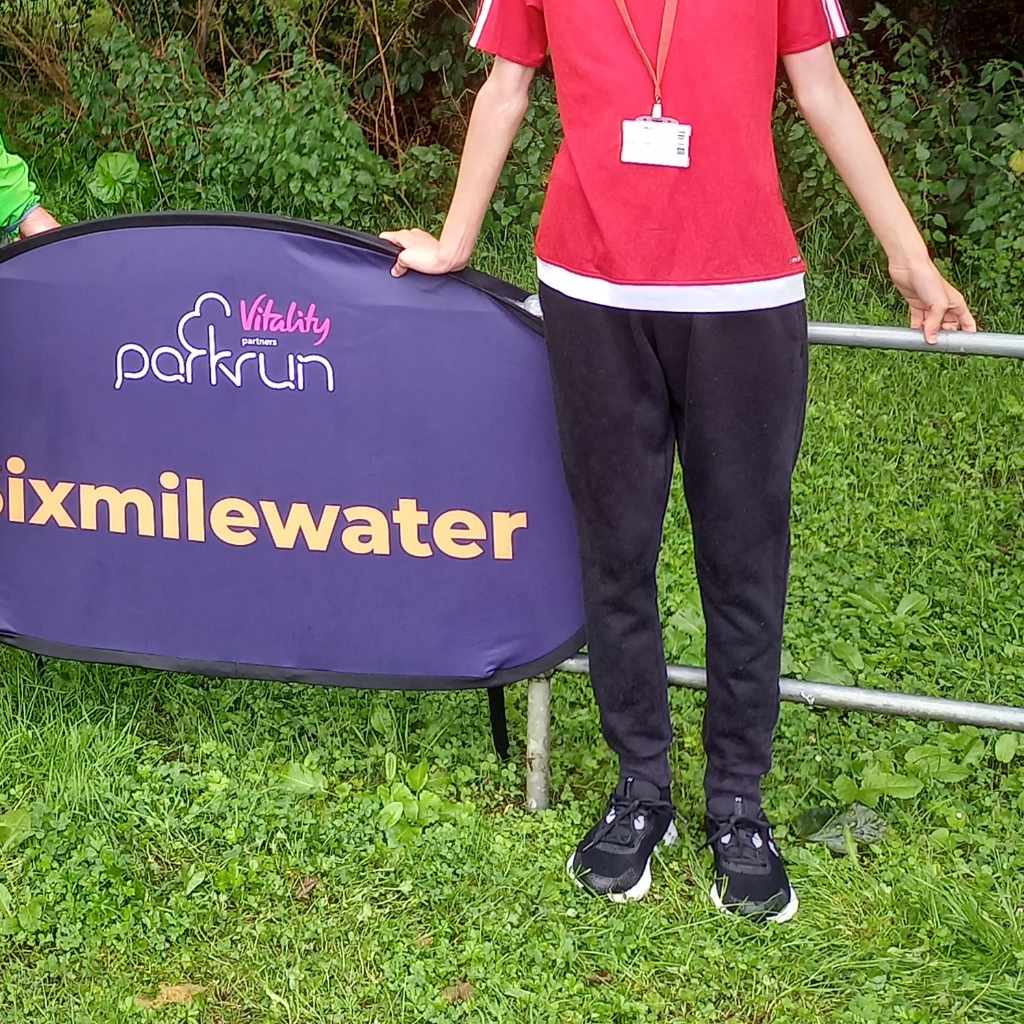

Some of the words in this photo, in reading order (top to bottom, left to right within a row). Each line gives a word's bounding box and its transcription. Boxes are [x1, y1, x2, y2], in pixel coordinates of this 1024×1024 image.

[239, 293, 332, 346] Vitality
[241, 337, 278, 347] partners
[114, 316, 335, 392] parkrun
